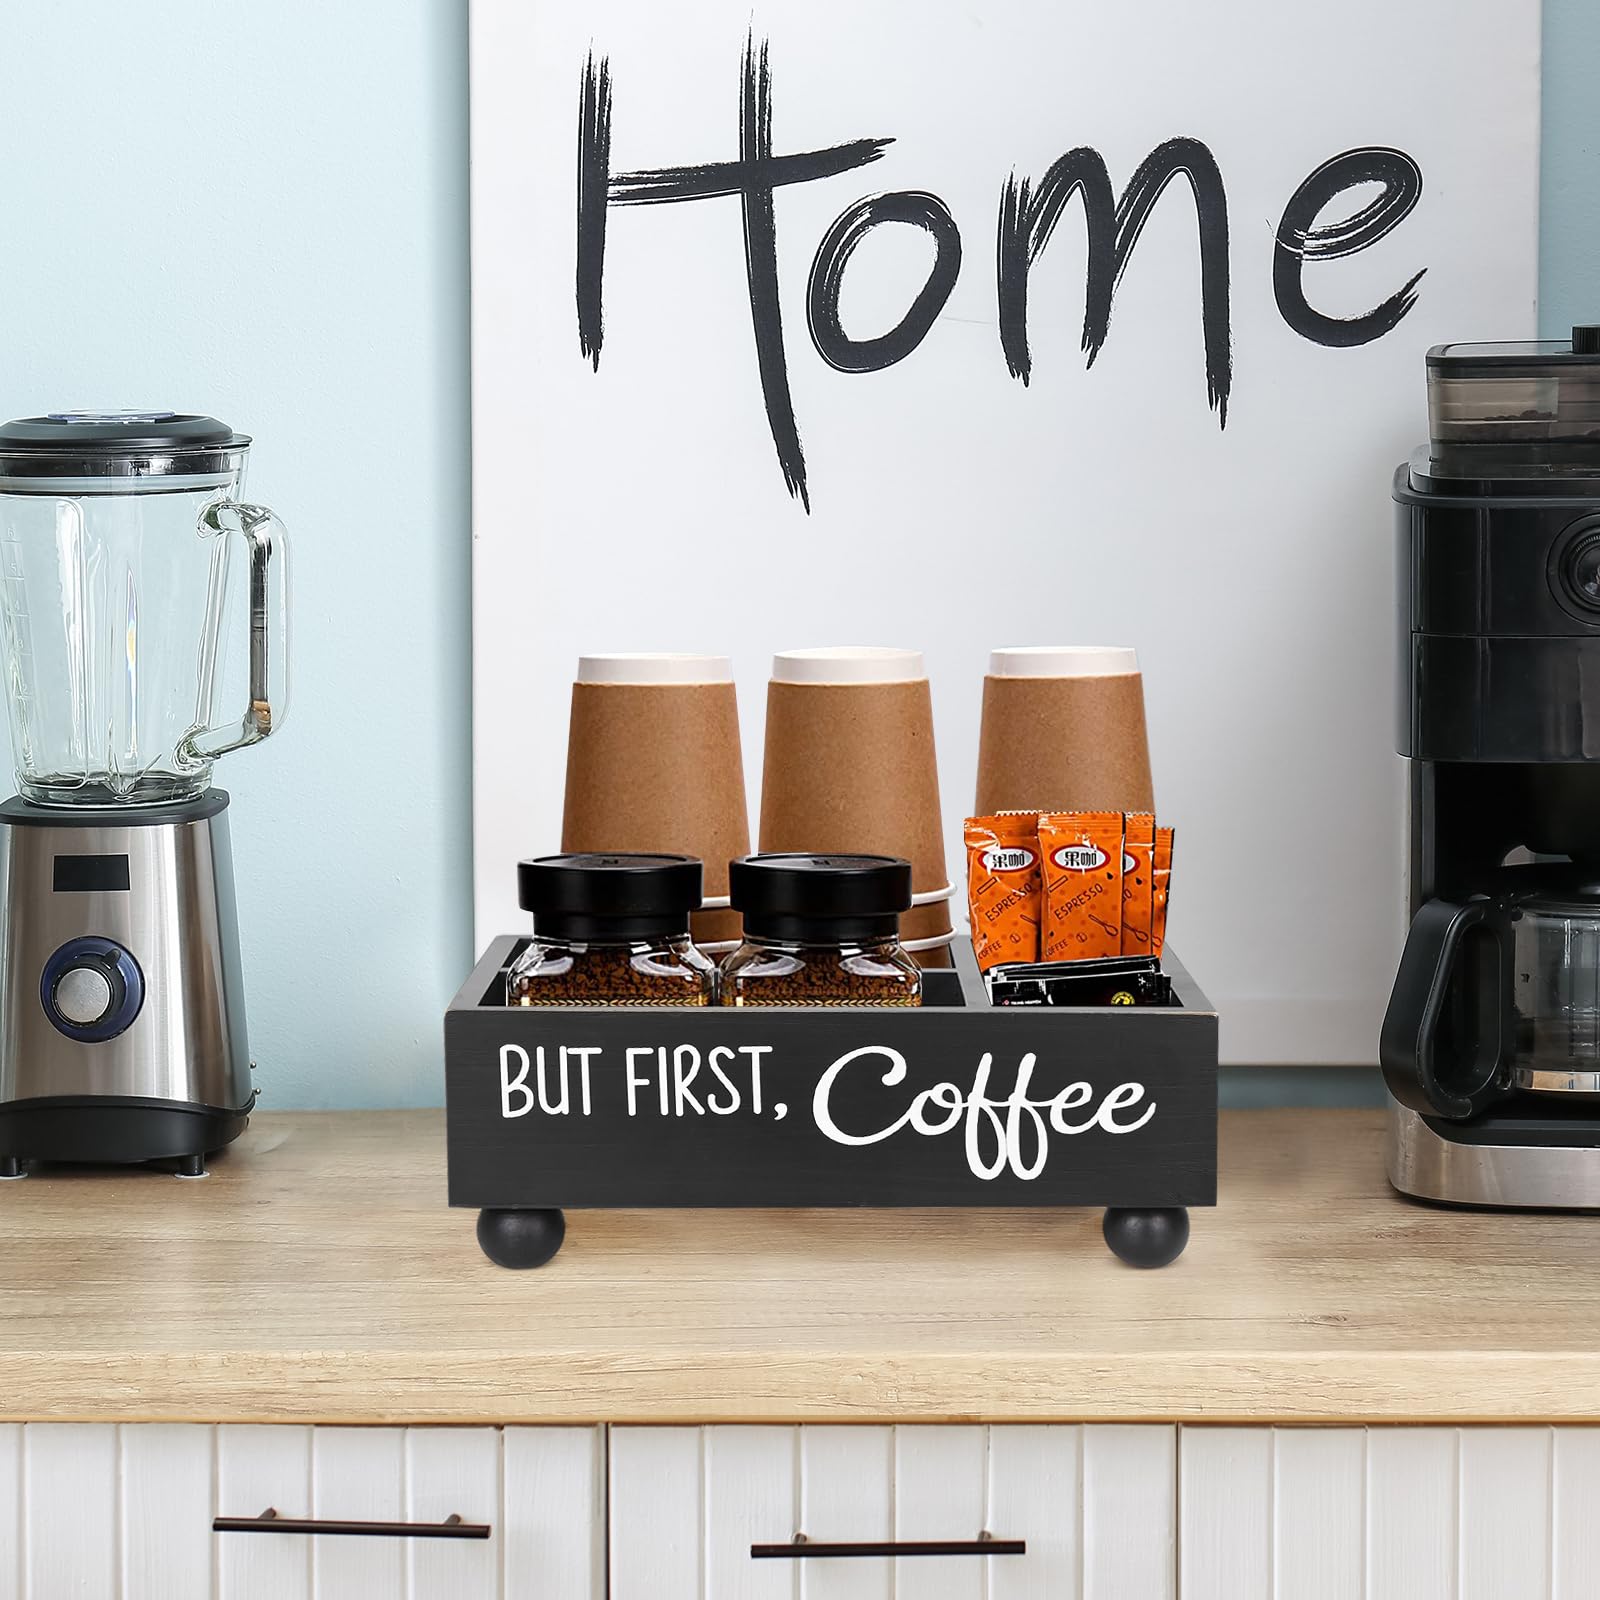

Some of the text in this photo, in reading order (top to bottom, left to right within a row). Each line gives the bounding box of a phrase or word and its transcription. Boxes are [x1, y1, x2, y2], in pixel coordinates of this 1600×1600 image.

[575, 12, 1428, 515] Home
[984, 882, 1033, 922] ESPRESSO
[1053, 882, 1104, 921] ESPRESSO
[977, 939, 1003, 960] COFFEE
[500, 1044, 1156, 1181] BUT FIRST, Coffee
